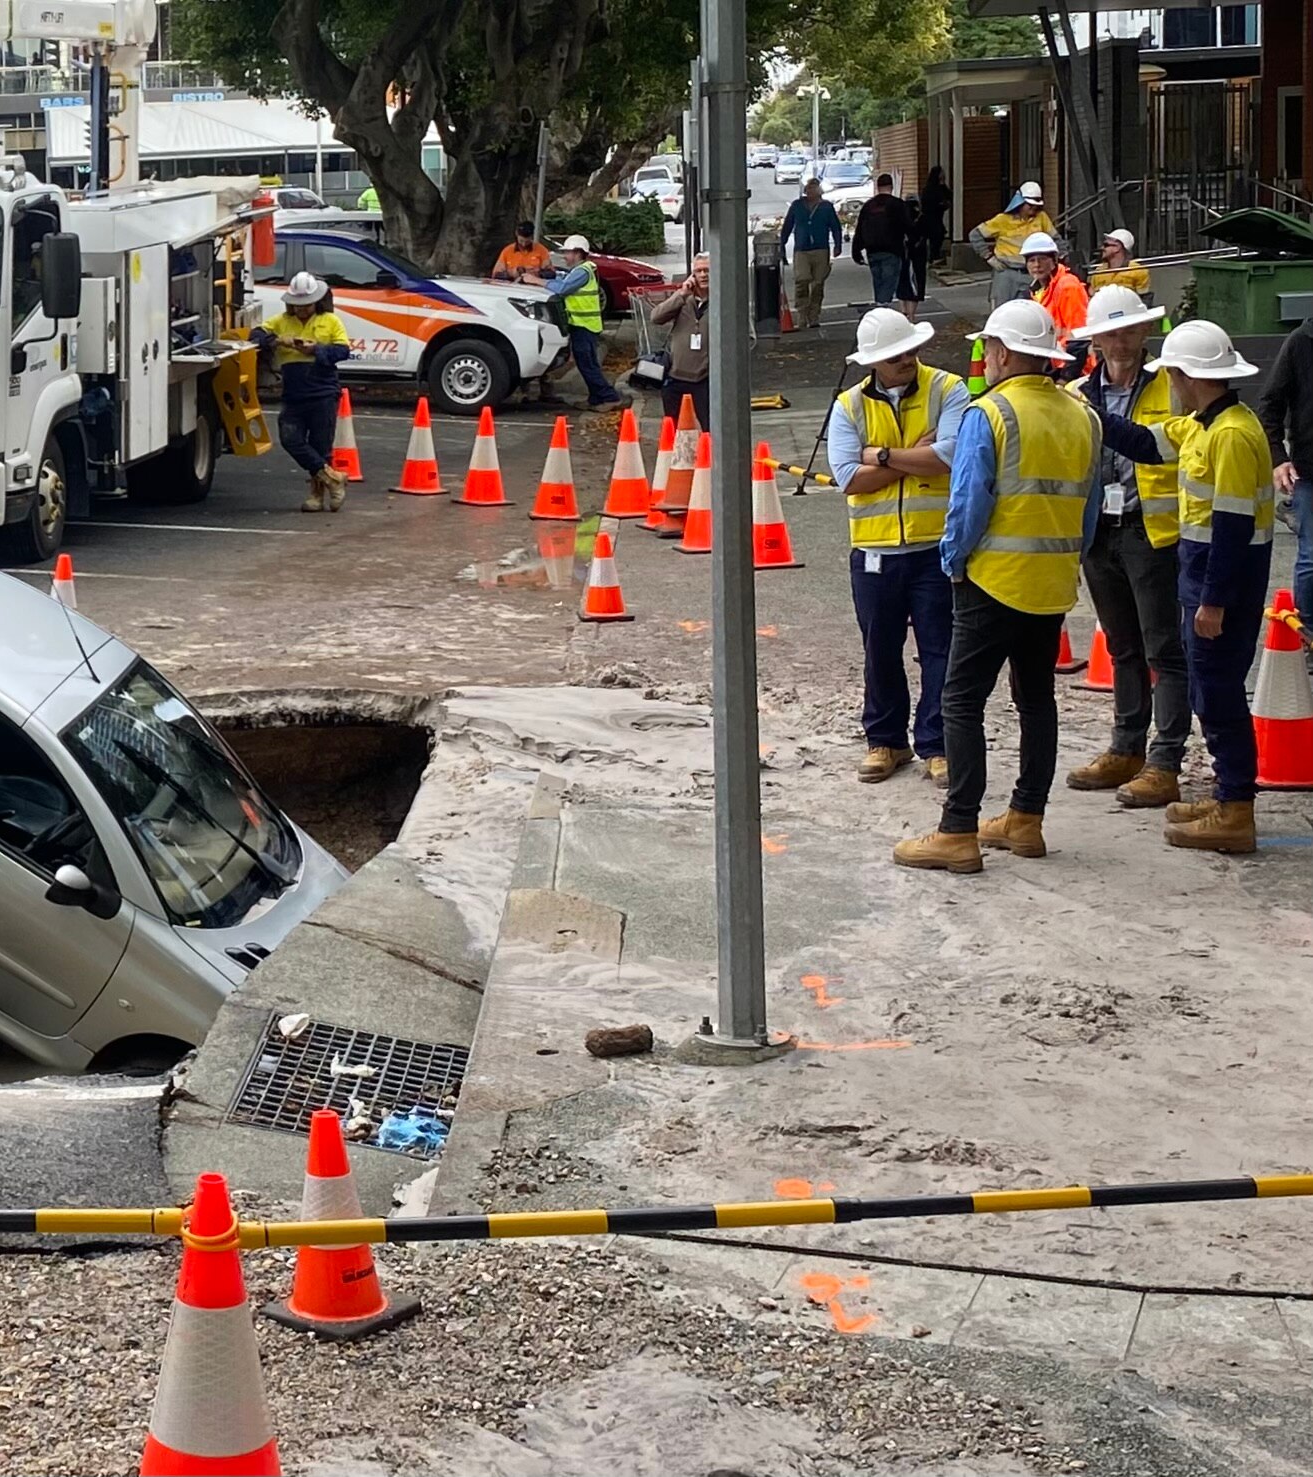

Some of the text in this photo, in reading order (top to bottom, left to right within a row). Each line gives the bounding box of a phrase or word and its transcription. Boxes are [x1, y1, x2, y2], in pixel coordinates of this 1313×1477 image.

[39, 96, 85, 108] BARS
[172, 91, 225, 103] BISTRO
[372, 338, 399, 353] 772
